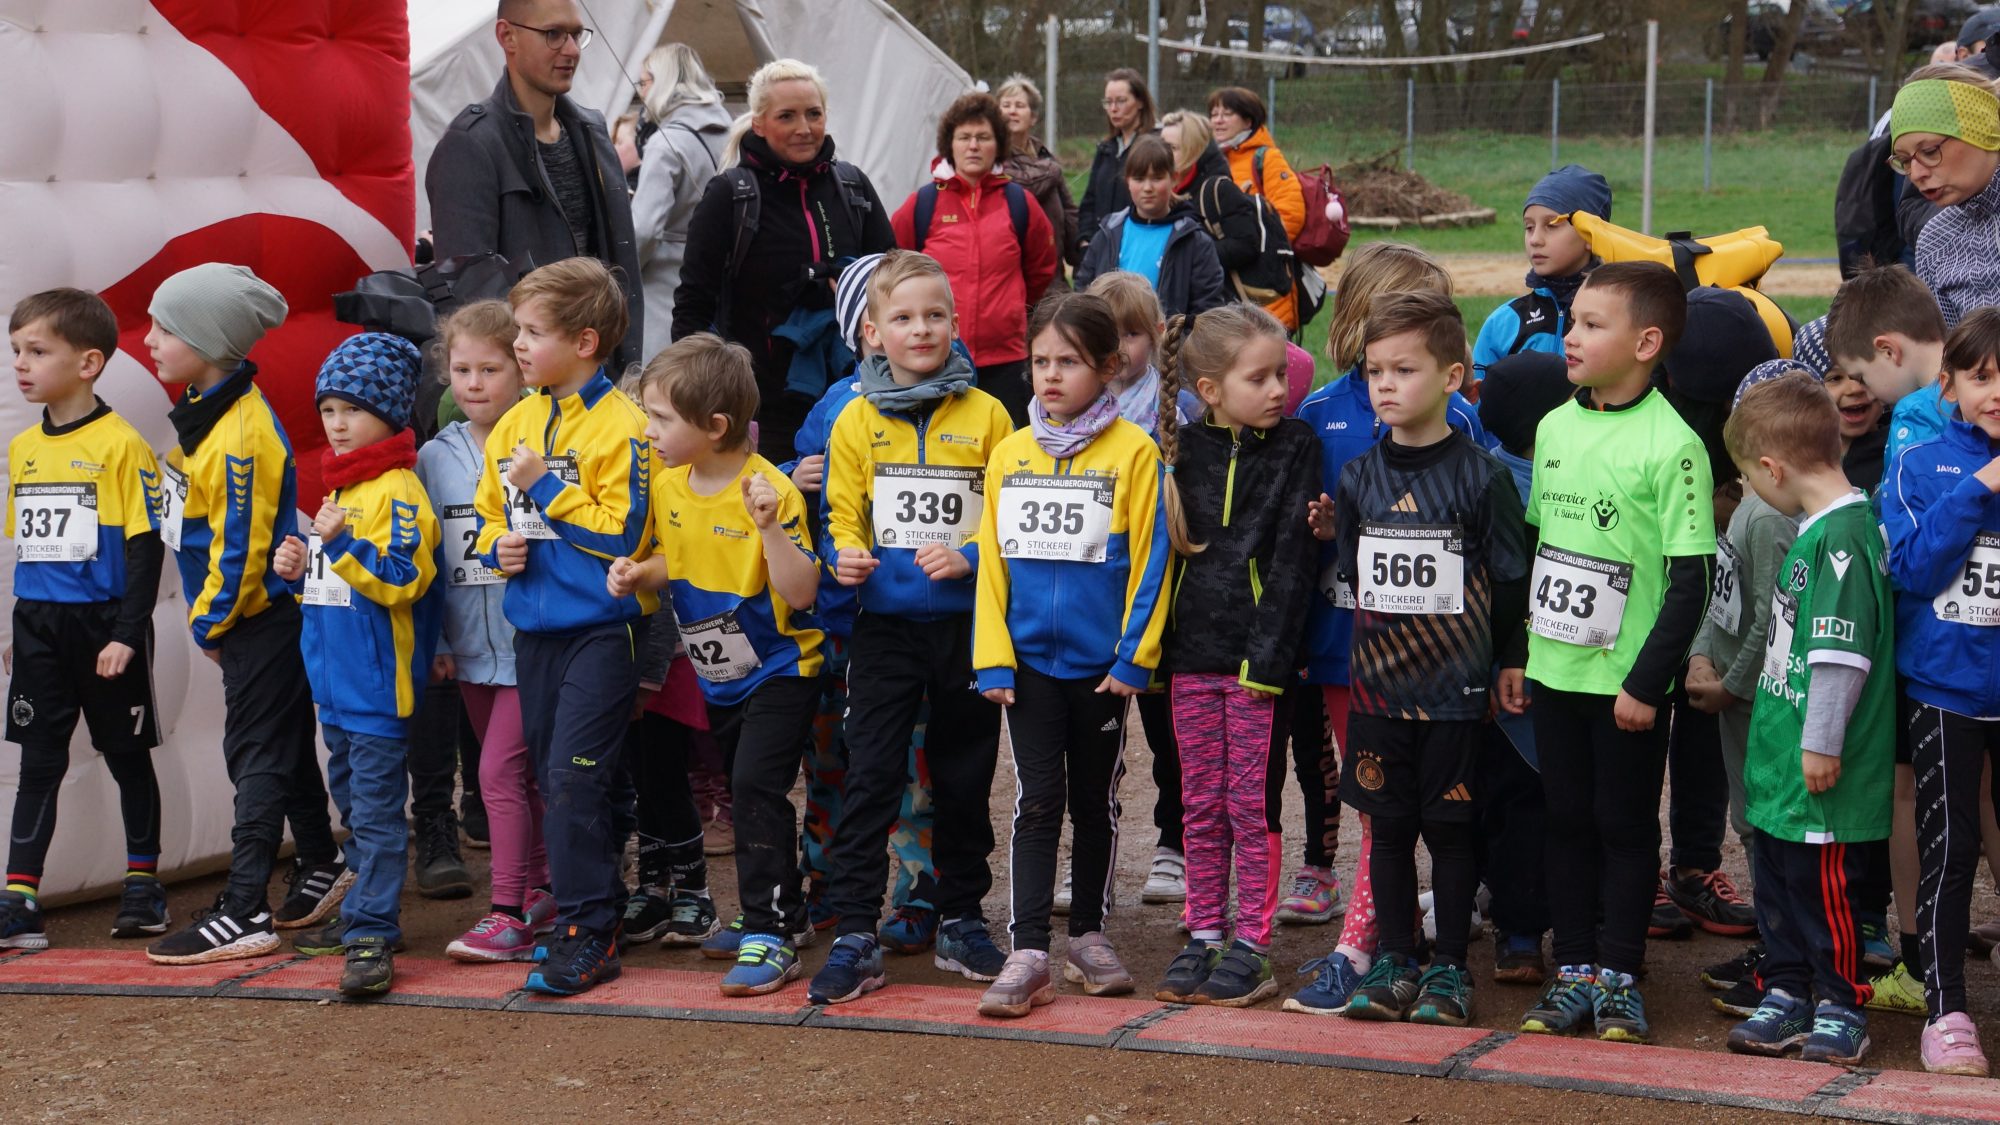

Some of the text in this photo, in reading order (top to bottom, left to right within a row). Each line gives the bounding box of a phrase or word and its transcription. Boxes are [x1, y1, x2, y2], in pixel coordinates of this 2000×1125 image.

[1326, 421, 1348, 430] JAKO
[1544, 459, 1560, 469] AKO
[1936, 464, 1961, 474] JAKO
[917, 468, 978, 478] SCHAUBERGWERK
[1042, 478, 1104, 489] SCHAUBERGWERK
[1097, 495, 1113, 503] 2023
[896, 490, 963, 526] 339
[21, 508, 72, 538] 337
[1018, 500, 1085, 535] 335
[905, 530, 952, 541] STICKEREI
[1387, 528, 1453, 539] SCHAUBERGWERK
[26, 544, 63, 553] STICKEREI
[1027, 540, 1072, 551] STICKEREI
[1447, 543, 1463, 551] 2023
[1557, 552, 1620, 574] SCHAUBERGWERK
[1372, 551, 1437, 588] 566
[1791, 562, 1809, 588] 96
[1611, 580, 1628, 589] 2023
[1715, 564, 1734, 604] 39
[1962, 560, 2000, 600] 55
[1380, 593, 1425, 605] STICKEREI
[1536, 574, 1597, 619] 433
[1384, 604, 1424, 612] TEXTILDRUCK
[725, 625, 740, 634] 2023
[1536, 616, 1579, 634] STICKEREI
[1813, 617, 1854, 641] HDI
[687, 640, 731, 666] 42
[968, 680, 979, 690] JA
[130, 704, 145, 735] 7
